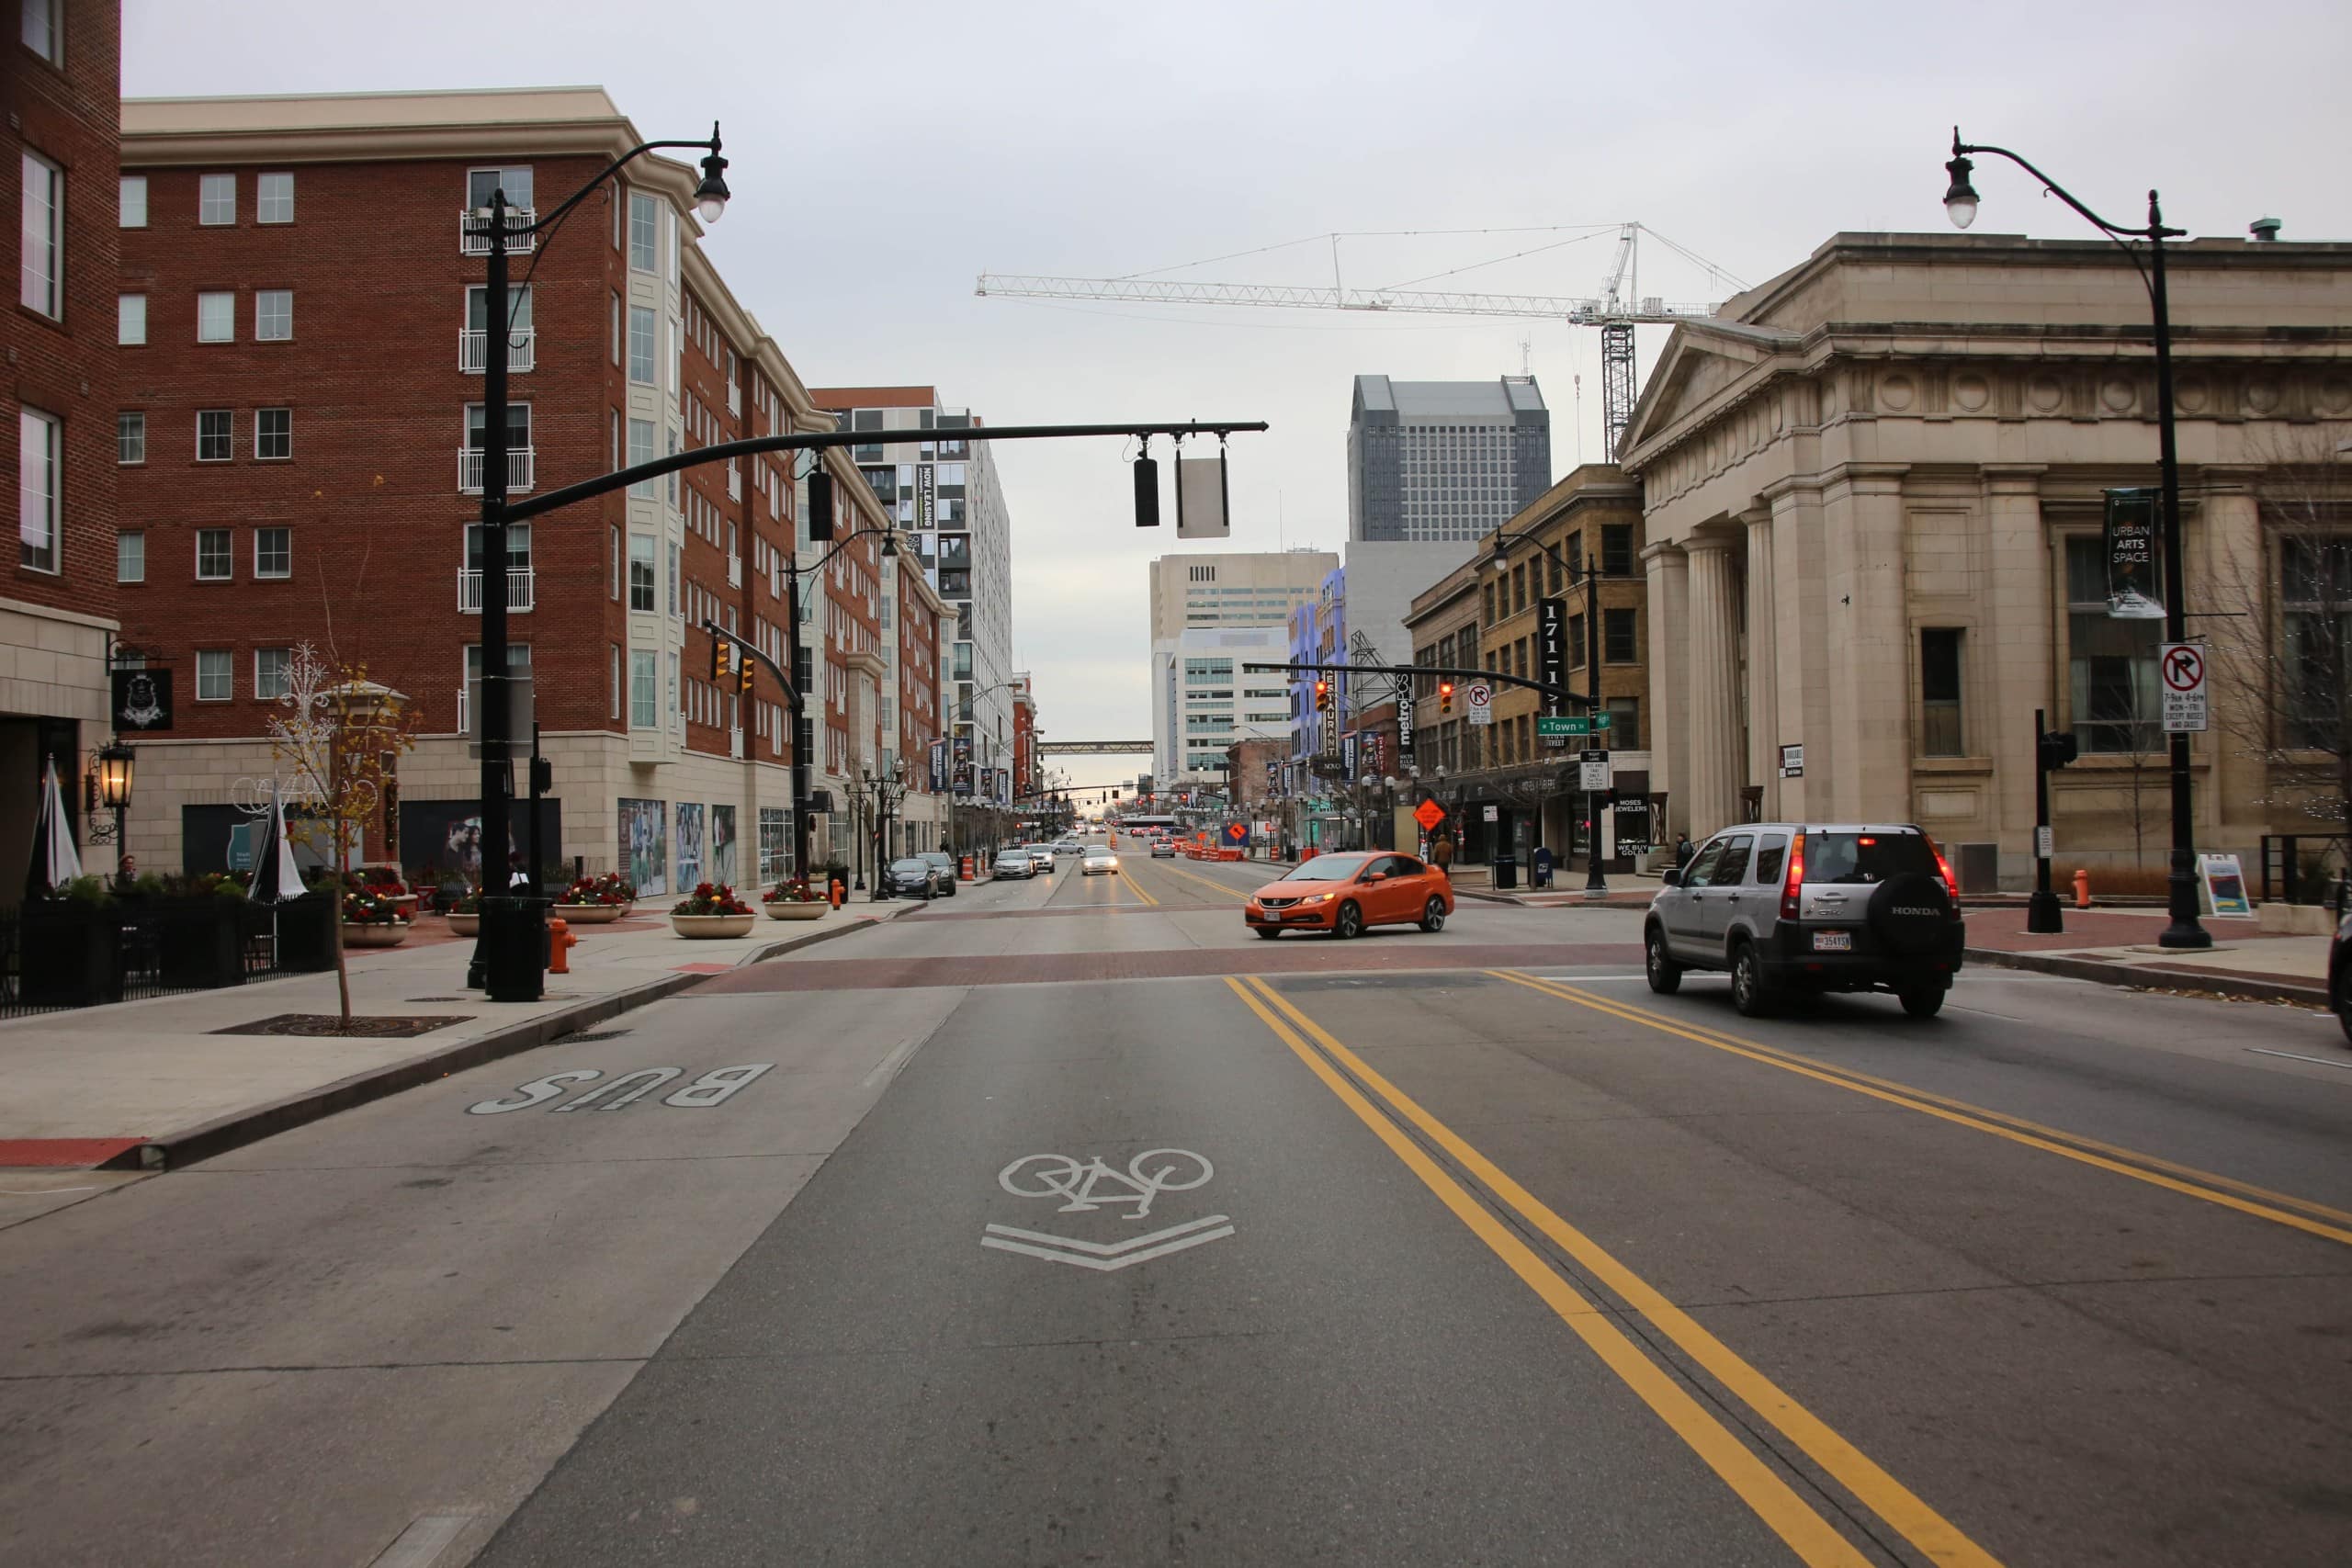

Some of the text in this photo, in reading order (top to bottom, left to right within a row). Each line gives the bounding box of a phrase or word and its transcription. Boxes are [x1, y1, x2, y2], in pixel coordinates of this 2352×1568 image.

[923, 467, 933, 526] NOW LEASING
[2112, 525, 2151, 536] URBAN
[2116, 538, 2145, 549] ARTS
[2112, 551, 2150, 563] SPACE
[1396, 673, 1410, 746] metroPCS
[1549, 721, 1577, 731] Town
[1892, 906, 1941, 916] HONDA
[469, 1063, 777, 1115] BUS
